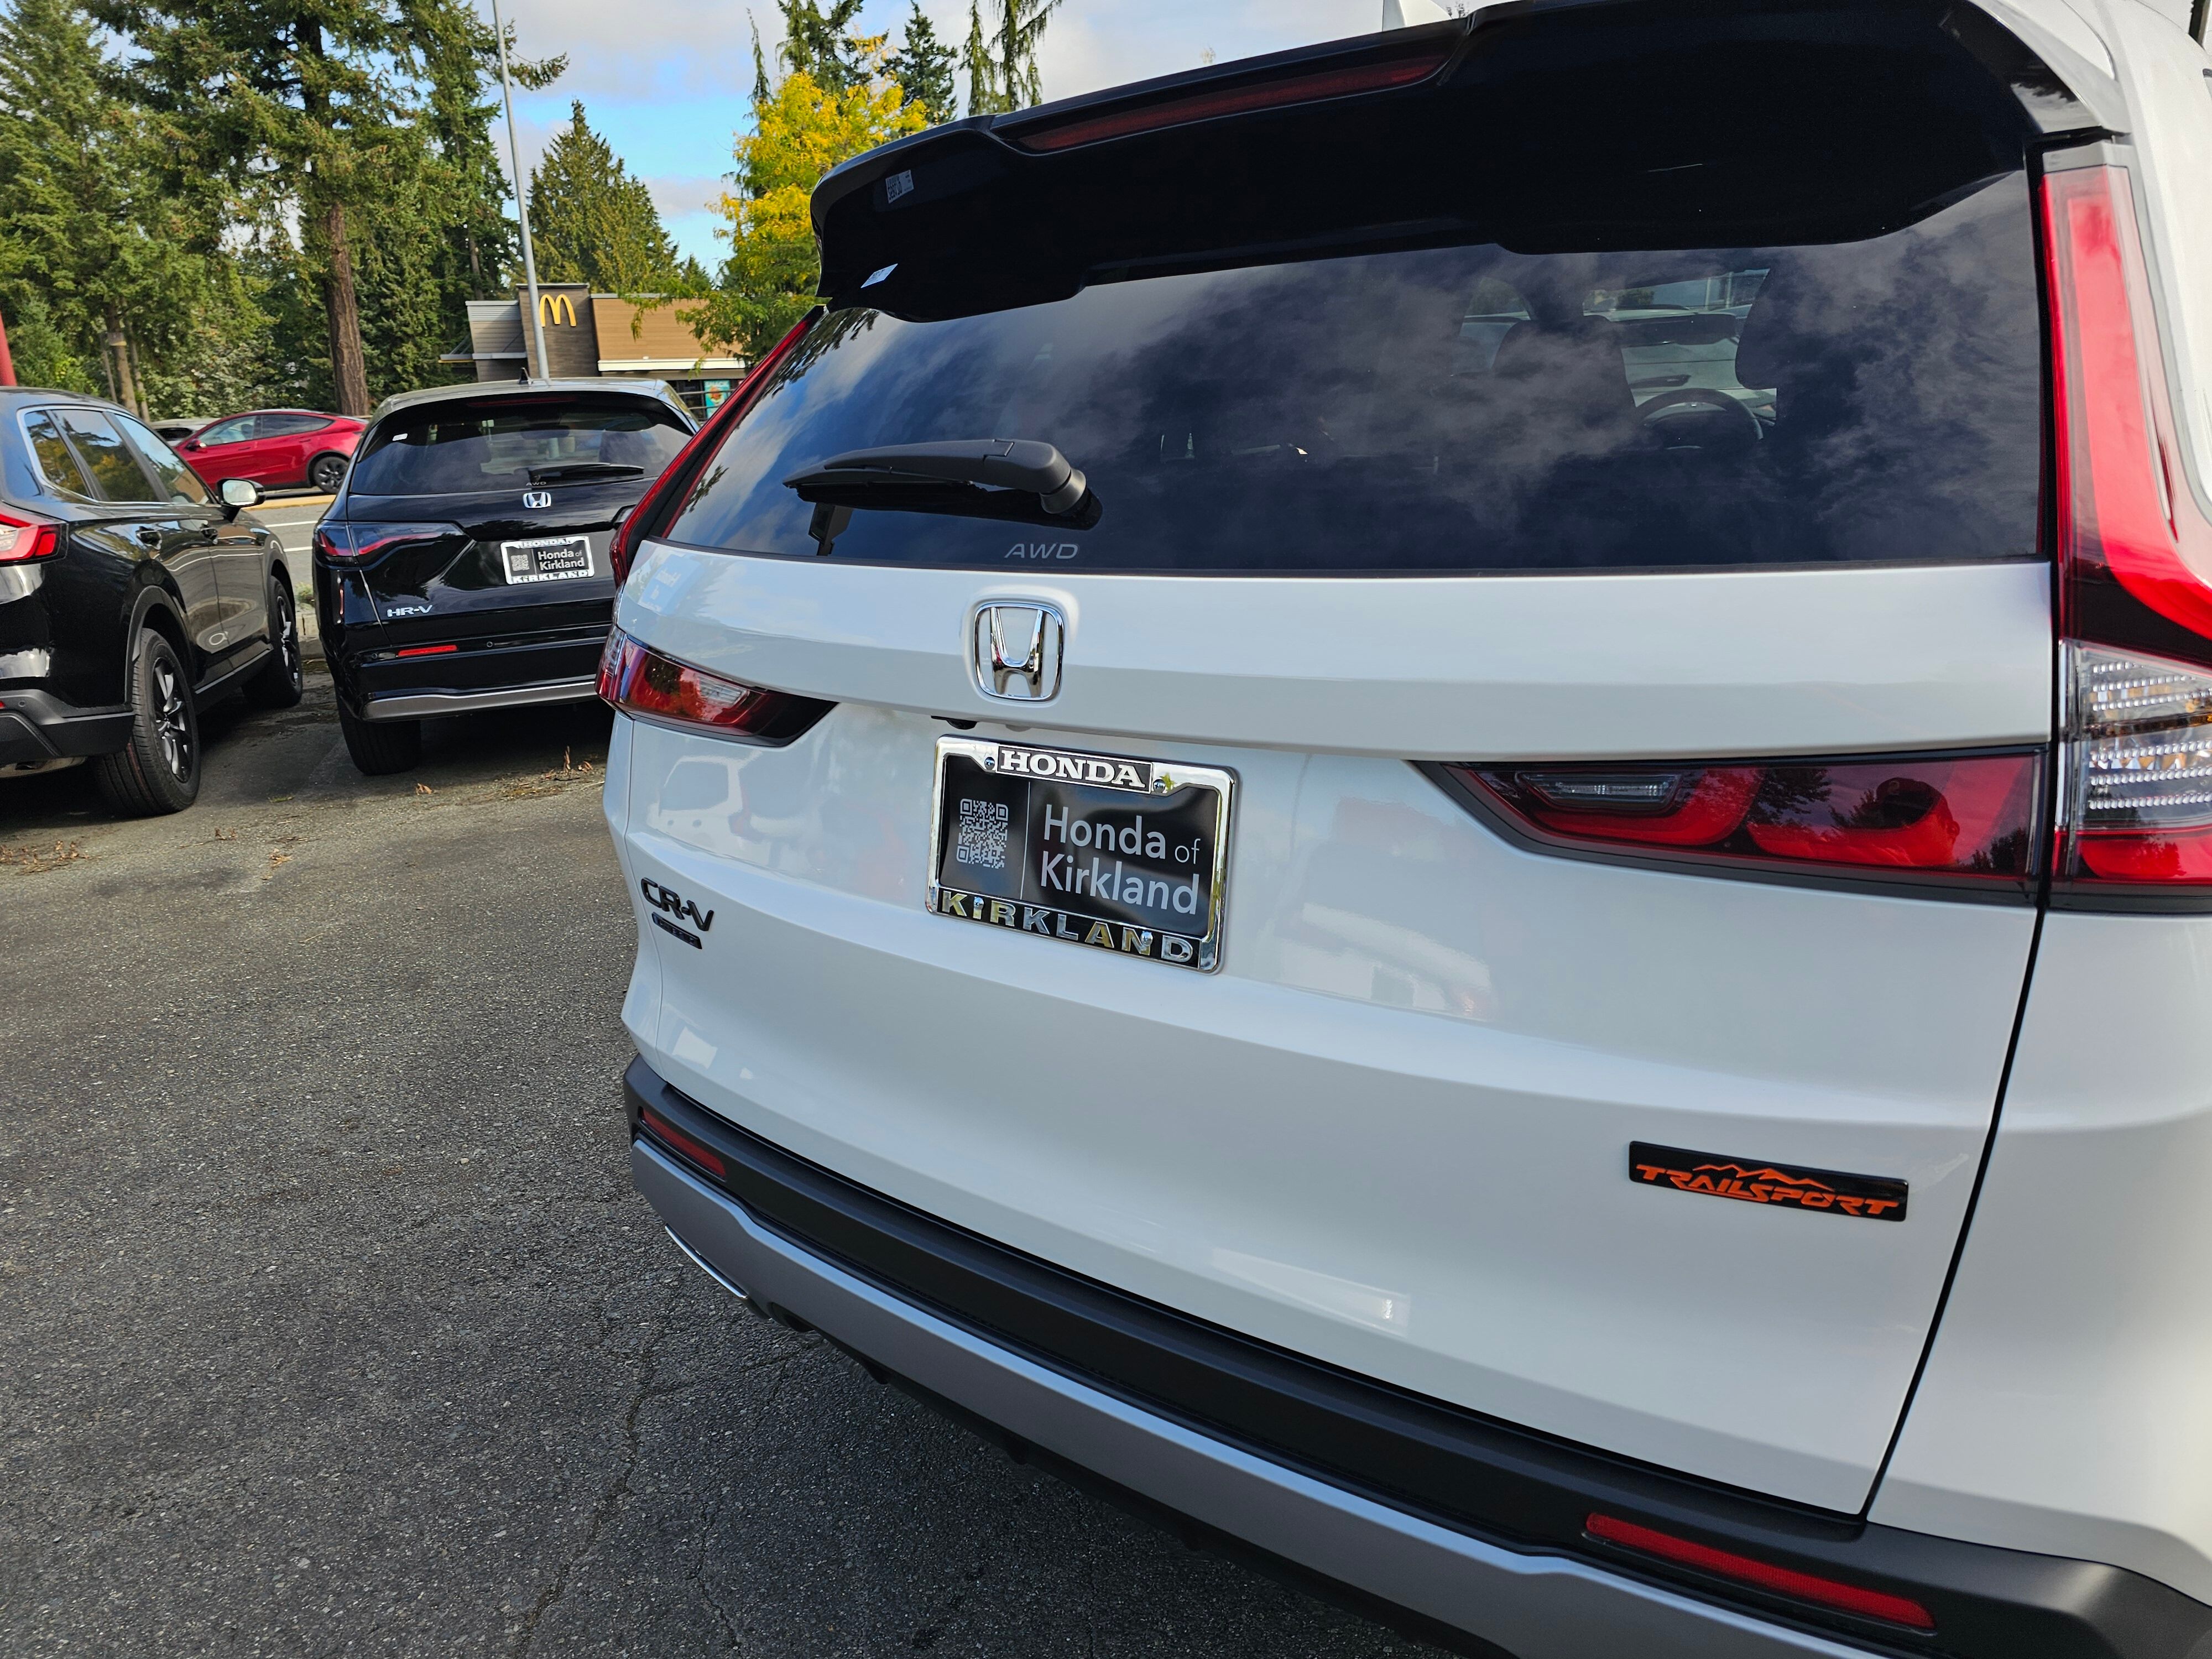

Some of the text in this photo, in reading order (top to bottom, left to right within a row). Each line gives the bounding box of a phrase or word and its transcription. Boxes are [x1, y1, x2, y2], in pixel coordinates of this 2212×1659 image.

[523, 539, 567, 548] HONDA
[538, 549, 574, 560] Honda
[1004, 544, 1079, 559] AWD
[513, 570, 588, 583] KIRKLAND
[540, 557, 585, 571] Kirkland
[387, 604, 433, 617] HR-V
[1000, 749, 1145, 789] HONDA
[1044, 804, 1201, 865] Honda of
[1041, 851, 1199, 915] Kirkland
[641, 877, 714, 931] CR-V
[942, 890, 1194, 963] KIRKLAND
[1636, 1164, 1899, 1216] TRAILSPORT
